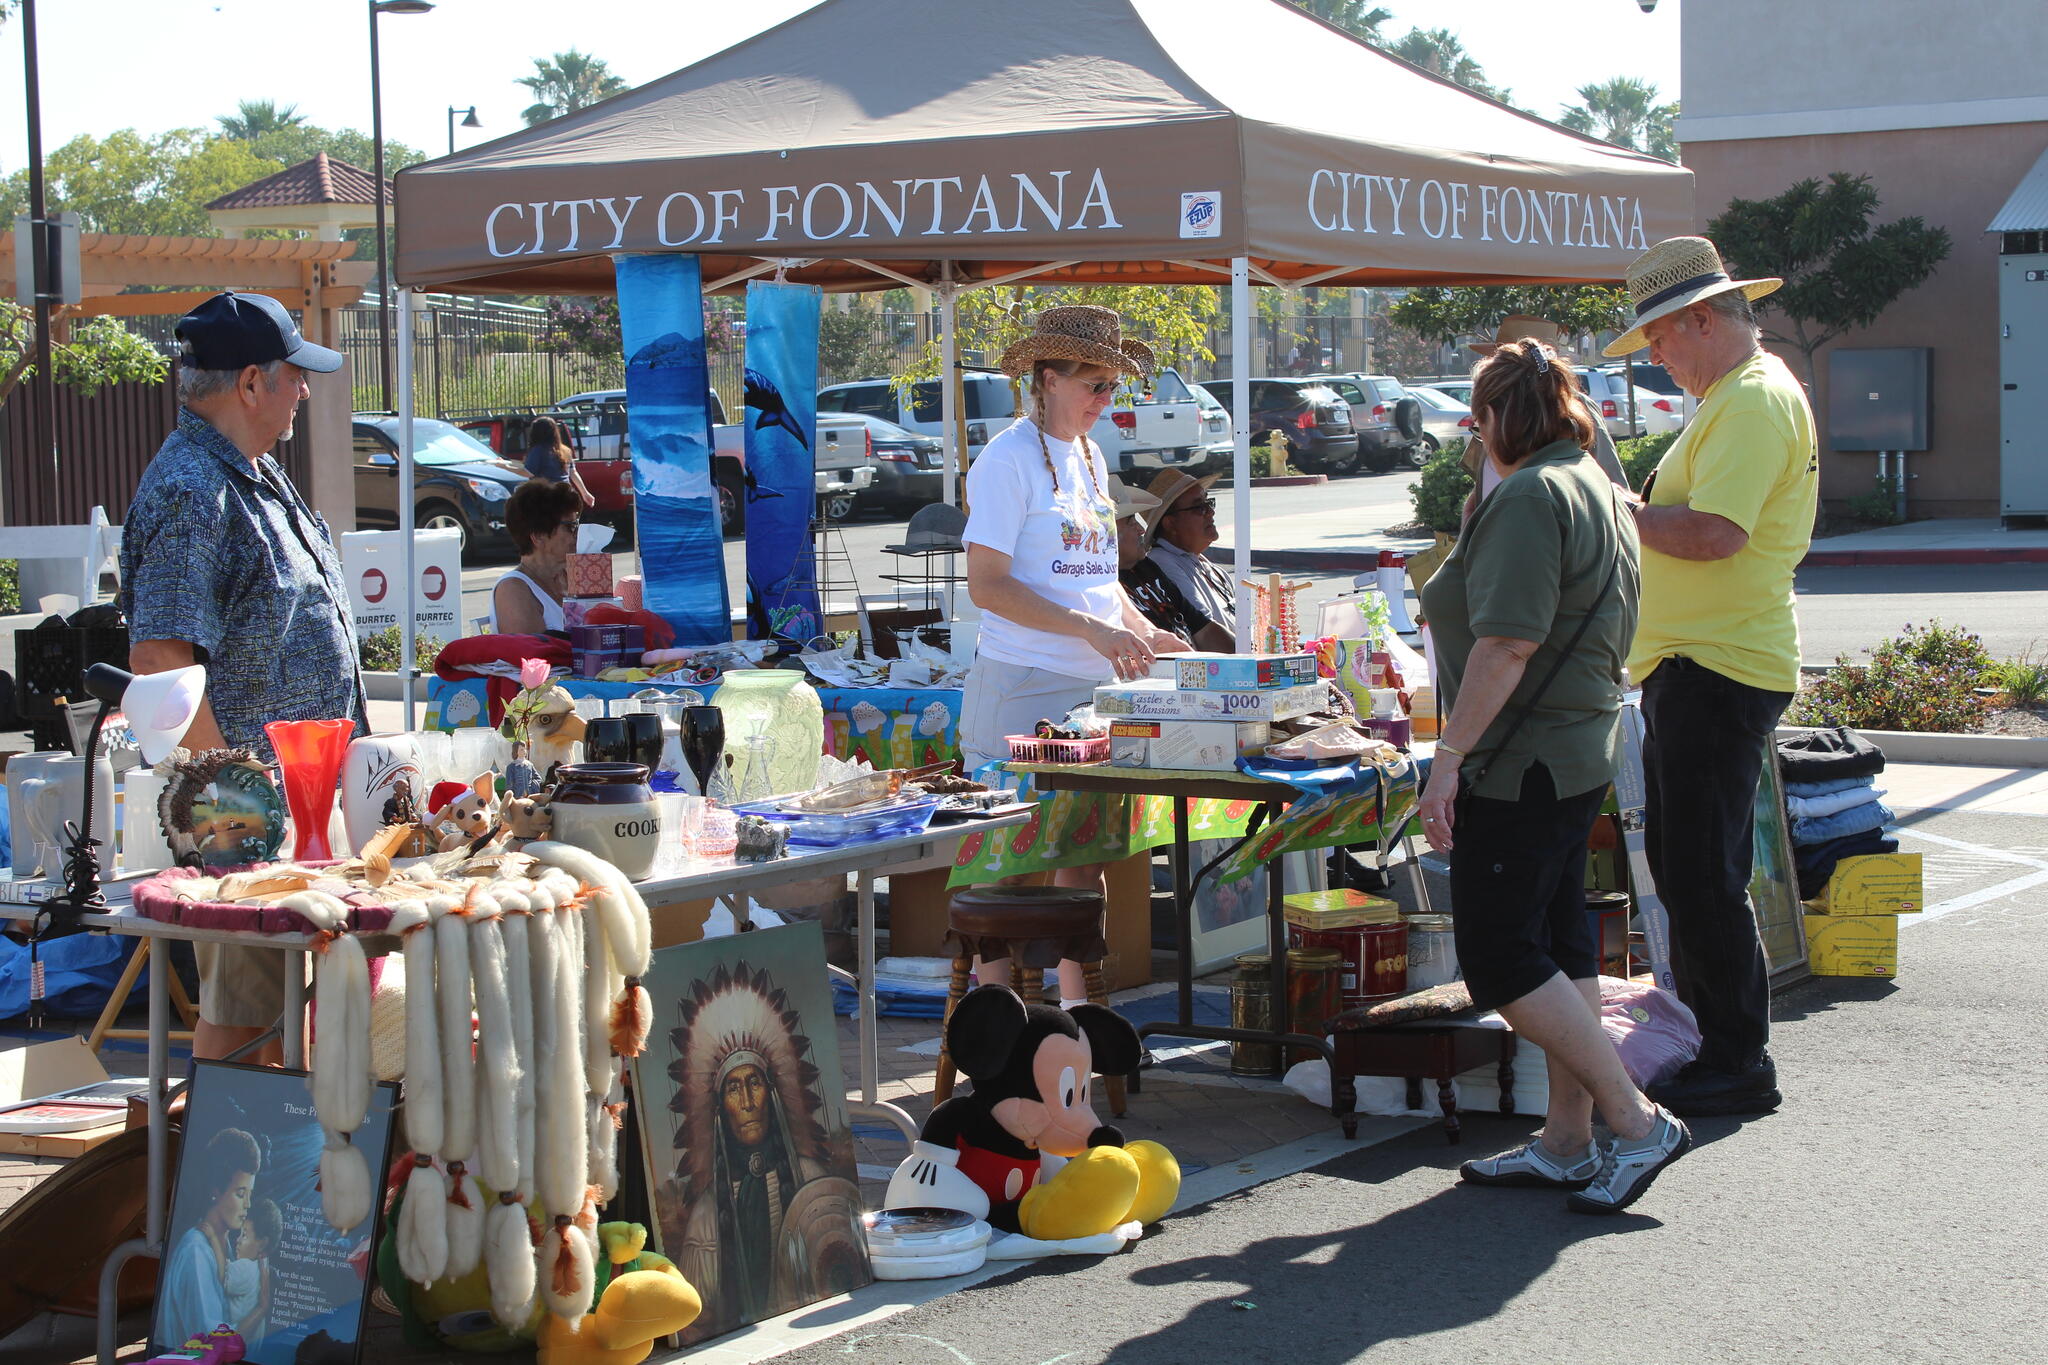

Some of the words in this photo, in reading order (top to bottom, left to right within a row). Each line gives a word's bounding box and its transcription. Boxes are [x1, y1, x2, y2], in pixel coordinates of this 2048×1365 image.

[485, 196, 642, 257] CITY
[657, 190, 744, 246] OF
[757, 167, 1123, 241] FONTANA
[1308, 168, 1410, 235] CITY
[1418, 179, 1470, 239] OF
[1479, 184, 1649, 250] FONTANA
[1051, 559, 1085, 578] Garage
[1086, 560, 1104, 575] Sale
[356, 614, 396, 625] BURRTEC
[416, 612, 454, 622] BURRTEC
[1130, 692, 1162, 705] Castles
[1166, 694, 1176, 704] &
[1220, 694, 1260, 715] 1000
[1129, 704, 1180, 716] Mansions
[283, 1102, 307, 1115] These
